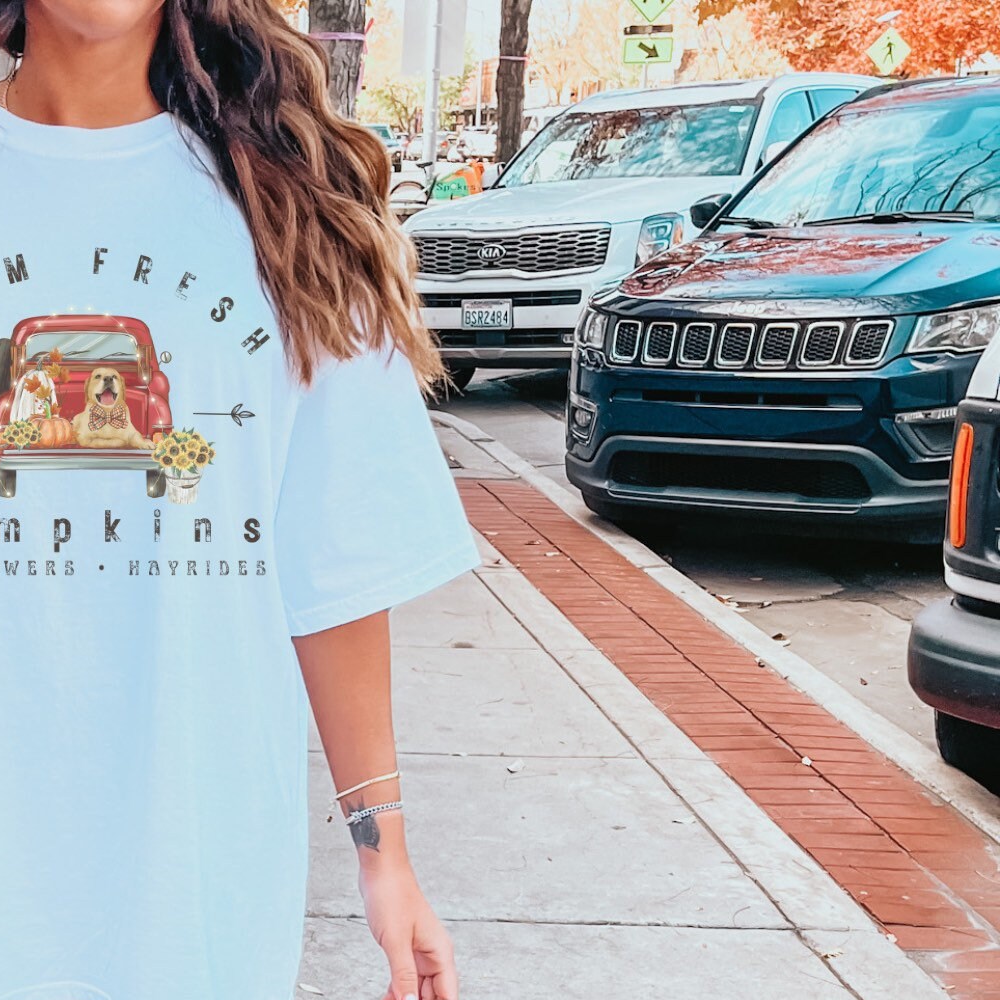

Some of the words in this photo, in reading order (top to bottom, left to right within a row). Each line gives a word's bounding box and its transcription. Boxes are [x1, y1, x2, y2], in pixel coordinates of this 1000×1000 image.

[480, 246, 501, 258] KIA
[93, 247, 271, 356] FRESH
[465, 310, 508, 325] BSR2484
[129, 560, 267, 576] HAYRIDES
